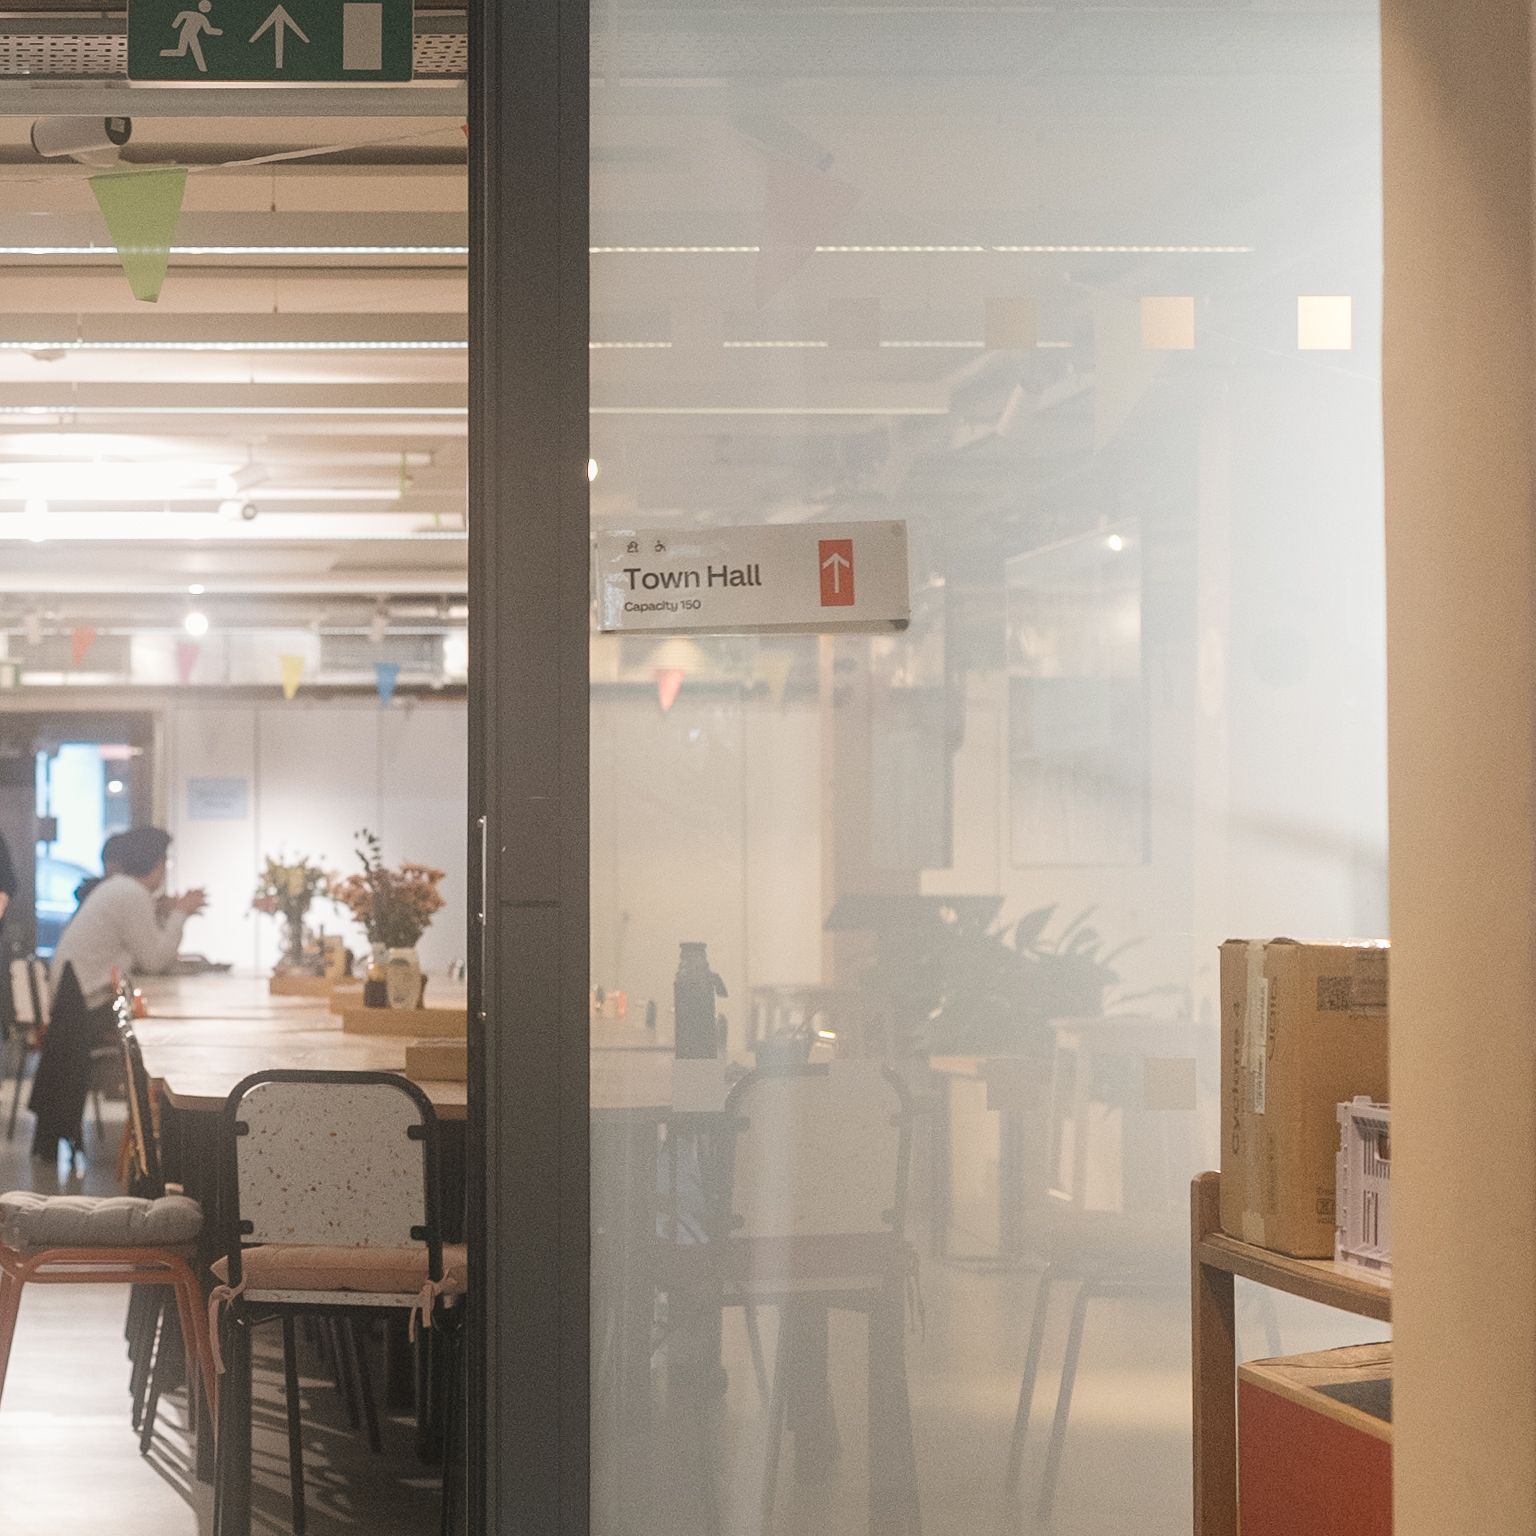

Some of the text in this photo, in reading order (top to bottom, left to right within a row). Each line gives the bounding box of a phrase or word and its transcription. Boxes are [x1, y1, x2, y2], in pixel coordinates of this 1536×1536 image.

[623, 564, 762, 590] Town Hall
[624, 599, 702, 613] Capacity 150
